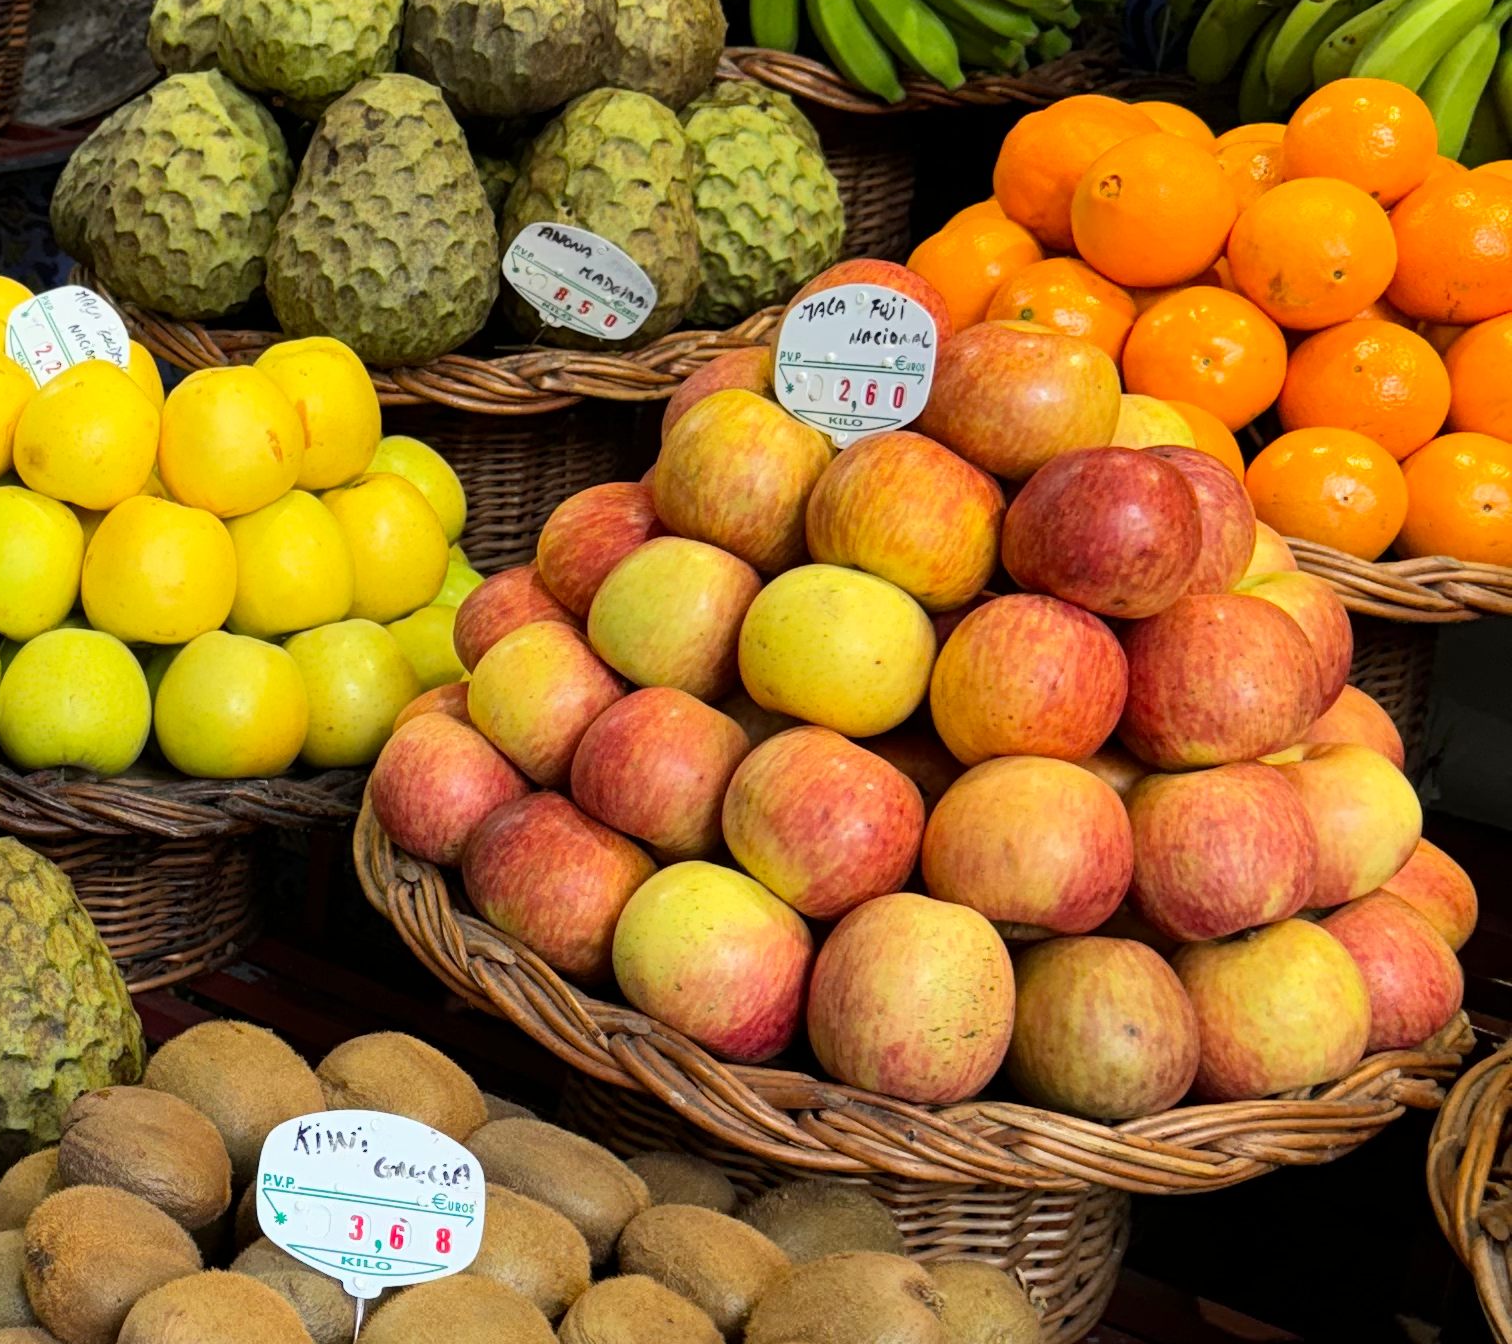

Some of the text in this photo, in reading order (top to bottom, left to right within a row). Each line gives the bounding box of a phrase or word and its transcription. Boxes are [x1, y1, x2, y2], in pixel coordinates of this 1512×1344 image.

[537, 227, 592, 259] ANONA
[849, 328, 932, 348] NACIONAL
[35, 344, 62, 374] 2,2
[838, 379, 905, 412] 2,60
[828, 416, 863, 427] KILO
[348, 1215, 452, 1254] 3,68
[341, 1256, 392, 1271] KILO
